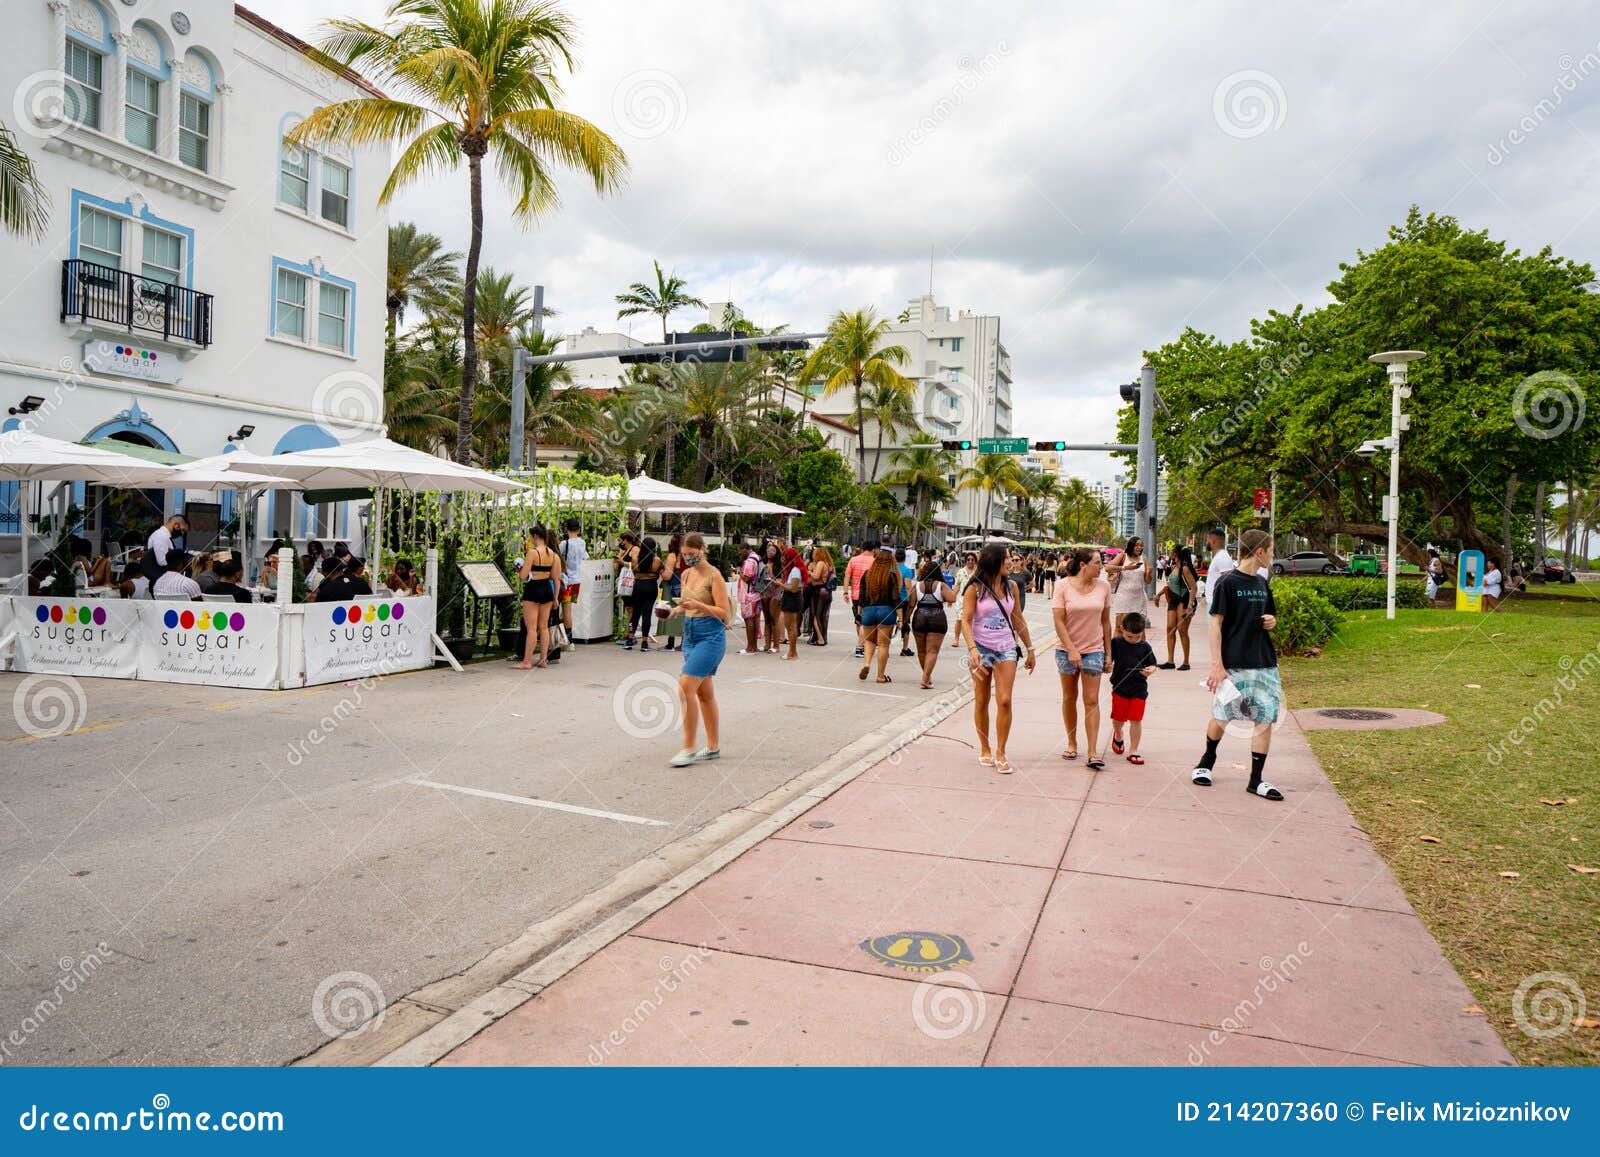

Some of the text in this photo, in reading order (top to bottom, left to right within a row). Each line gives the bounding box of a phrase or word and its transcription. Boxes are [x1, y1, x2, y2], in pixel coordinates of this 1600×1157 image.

[113, 354, 157, 368] sugar
[993, 444, 1000, 453] 11
[33, 625, 106, 645] sugar
[329, 622, 403, 642] sugar
[161, 631, 243, 652] sugar
[167, 651, 235, 661] FACTORY
